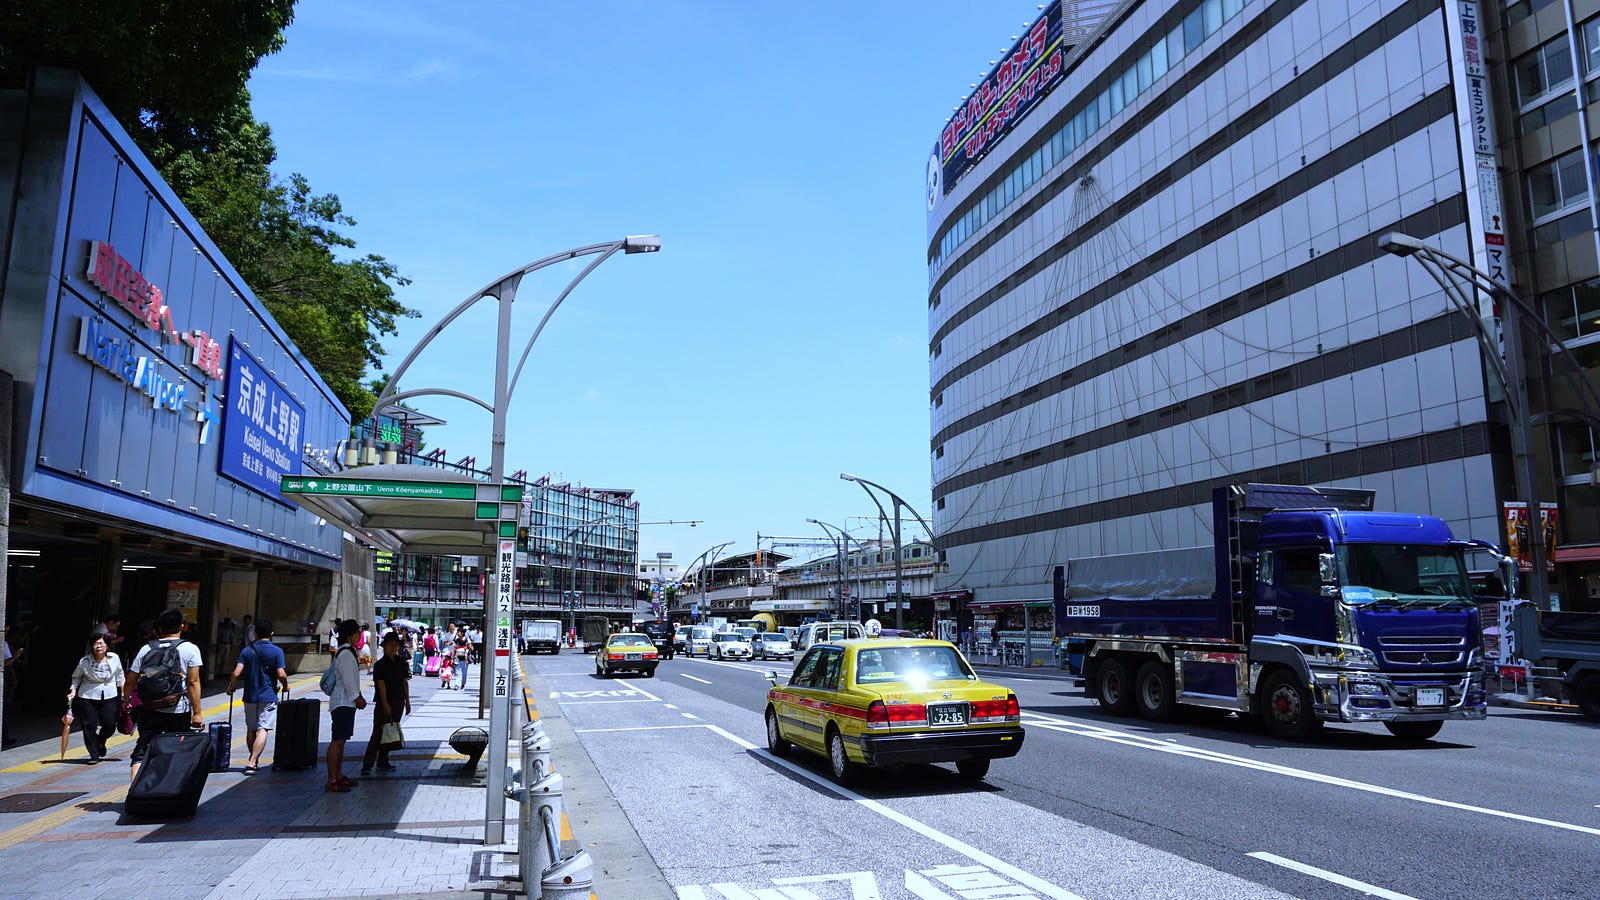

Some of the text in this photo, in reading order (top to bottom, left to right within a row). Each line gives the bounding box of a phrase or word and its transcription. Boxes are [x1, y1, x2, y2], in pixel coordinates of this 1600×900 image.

[1461, 3, 1481, 66] 上野歯科
[943, 15, 1048, 160] ヨドバシカメラ
[965, 48, 1062, 159] マルチメディア上野
[1471, 78, 1486, 143] 富士コンタクト
[78, 316, 137, 384] Narita
[237, 366, 300, 454] 京成上野駅
[243, 425, 262, 452] Keisei
[261, 435, 275, 462] Ueno
[274, 447, 291, 472] Station
[323, 482, 372, 492] 上野公園山下
[377, 485, 394, 493] Ueno
[499, 552, 512, 612] 観光路線バス
[497, 628, 509, 648] 浅草
[498, 617, 510, 627] S-1
[495, 675, 507, 696] 方面
[938, 712, 963, 723] 22-85
